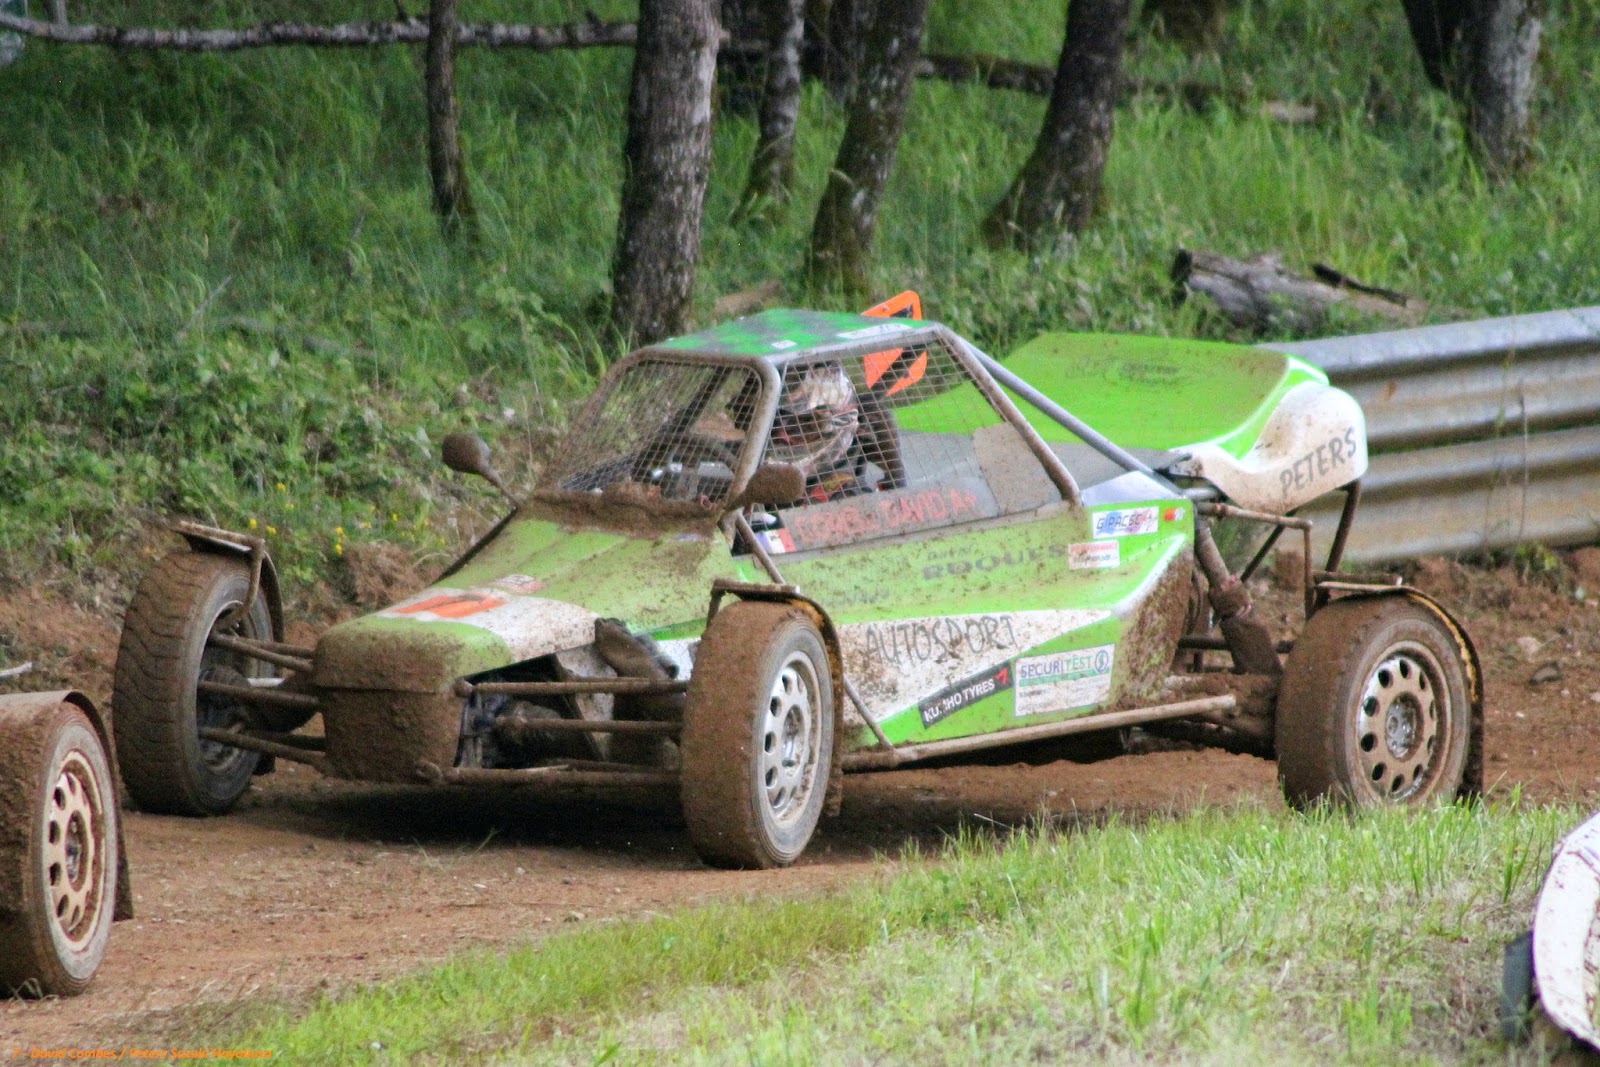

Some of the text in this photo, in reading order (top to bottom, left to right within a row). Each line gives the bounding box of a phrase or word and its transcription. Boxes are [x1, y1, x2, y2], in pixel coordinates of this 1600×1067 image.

[1280, 427, 1356, 499] PETERS
[865, 615, 1018, 667] AUTOSPORT
[1020, 655, 1093, 678] SECURITEST
[962, 678, 996, 699] TYRES
